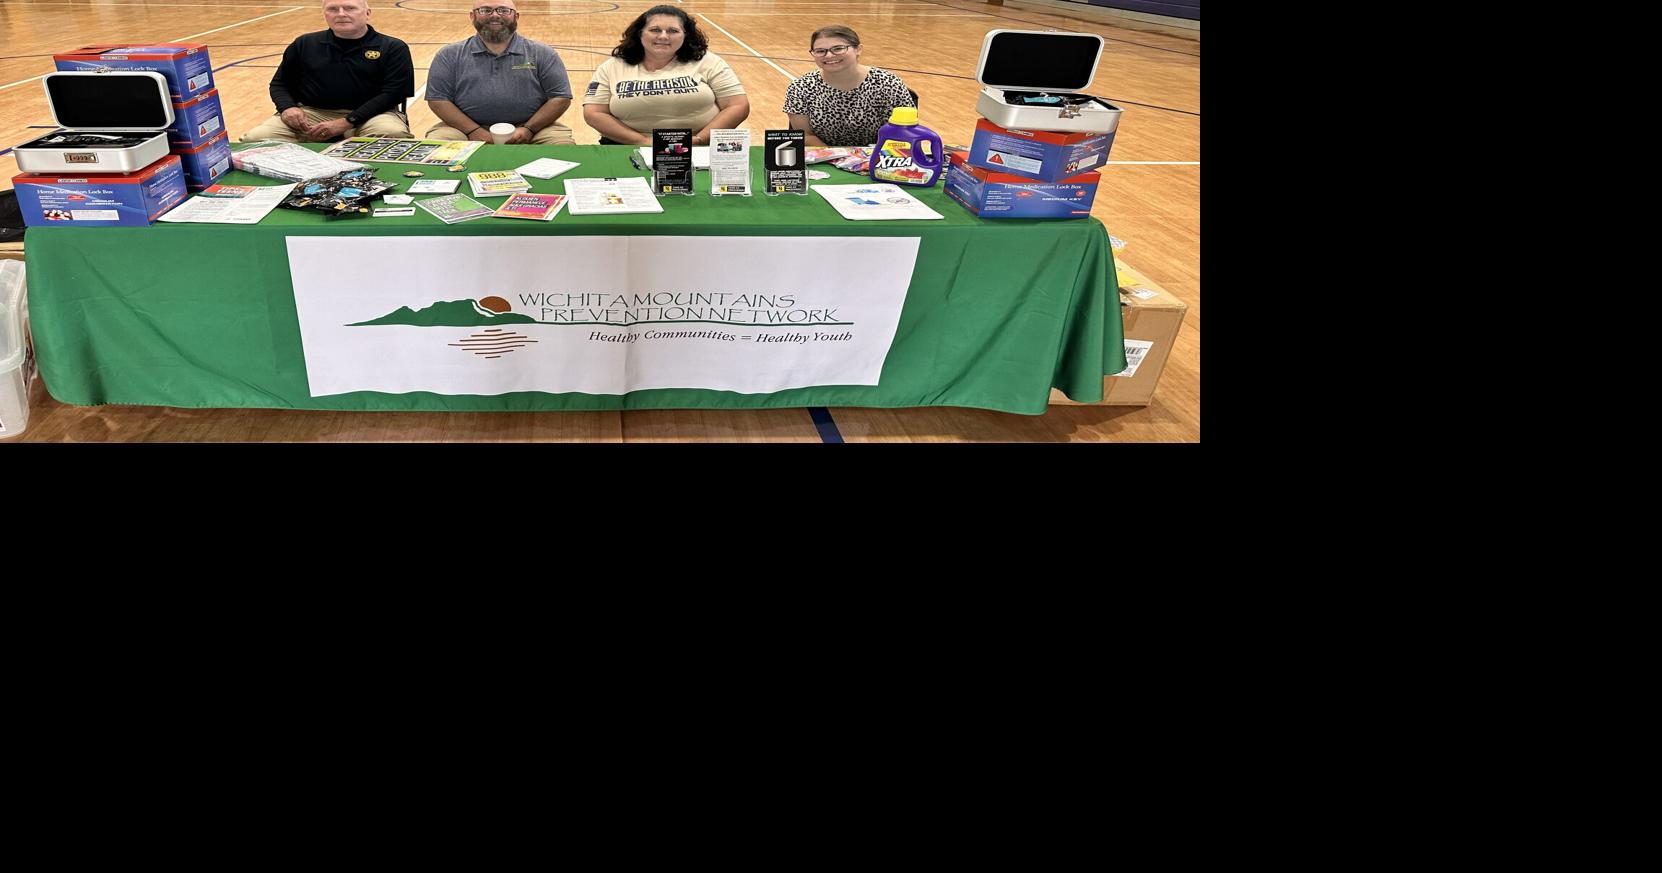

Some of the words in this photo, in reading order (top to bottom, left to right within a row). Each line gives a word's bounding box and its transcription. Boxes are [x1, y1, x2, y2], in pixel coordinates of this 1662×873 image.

[619, 81, 631, 92] BE
[632, 80, 650, 91] THE
[652, 76, 695, 90] REASON
[617, 91, 641, 99] THEY
[875, 155, 912, 169] XTRA
[479, 171, 506, 180] 988
[519, 292, 628, 308] WICHITA
[633, 291, 795, 308] MOUNTAINS
[541, 307, 703, 323] PREVENTION
[709, 307, 839, 323] NETWORK
[589, 331, 640, 344] Healthy
[644, 330, 736, 342] Communities
[756, 332, 810, 345] Healthy
[813, 332, 853, 342] Youth
